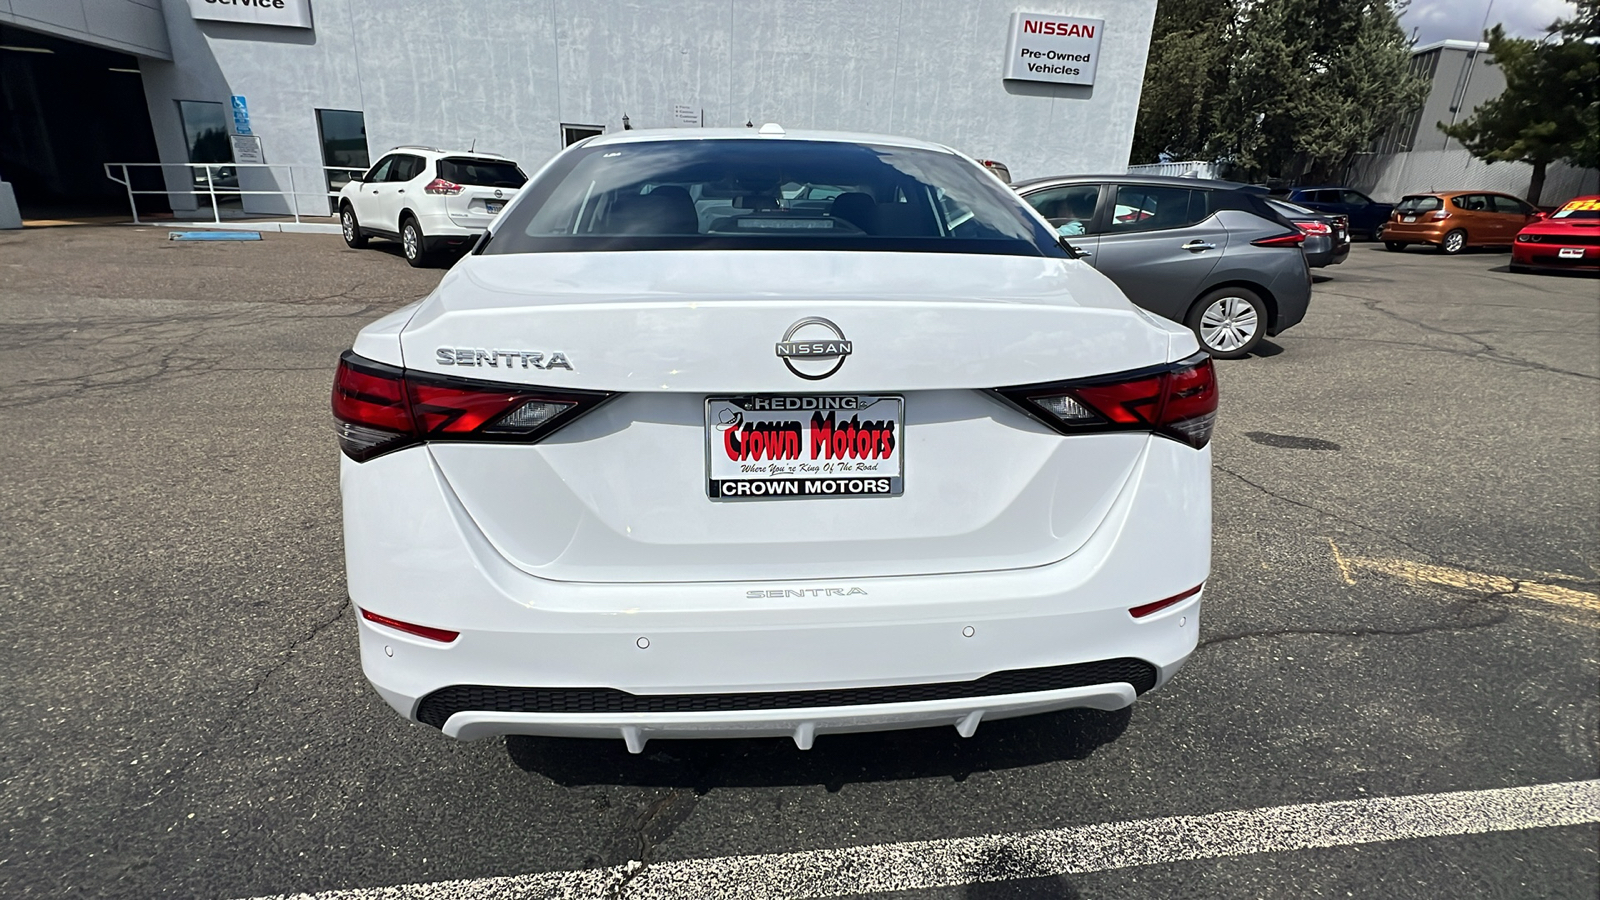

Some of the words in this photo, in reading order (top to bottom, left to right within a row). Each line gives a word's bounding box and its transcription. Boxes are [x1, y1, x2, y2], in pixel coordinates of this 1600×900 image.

[205, 0, 285, 9] rvice
[1023, 20, 1095, 38] NISSAN
[1021, 48, 1090, 62] Pre-Owned
[1027, 63, 1080, 75] Vehicles
[777, 343, 851, 354] NISSAN
[436, 346, 574, 371] SENTRA
[755, 397, 857, 410] REDDING
[724, 419, 802, 462] Crown
[810, 411, 895, 460] Motors
[740, 464, 767, 473] Where
[768, 463, 797, 474] You're
[799, 463, 820, 475] King
[822, 462, 835, 474] Of
[837, 462, 853, 472] The
[855, 462, 879, 472] Road
[722, 481, 799, 496] CROWN
[805, 479, 890, 495] MOTORS
[745, 587, 868, 599] SENTRA
